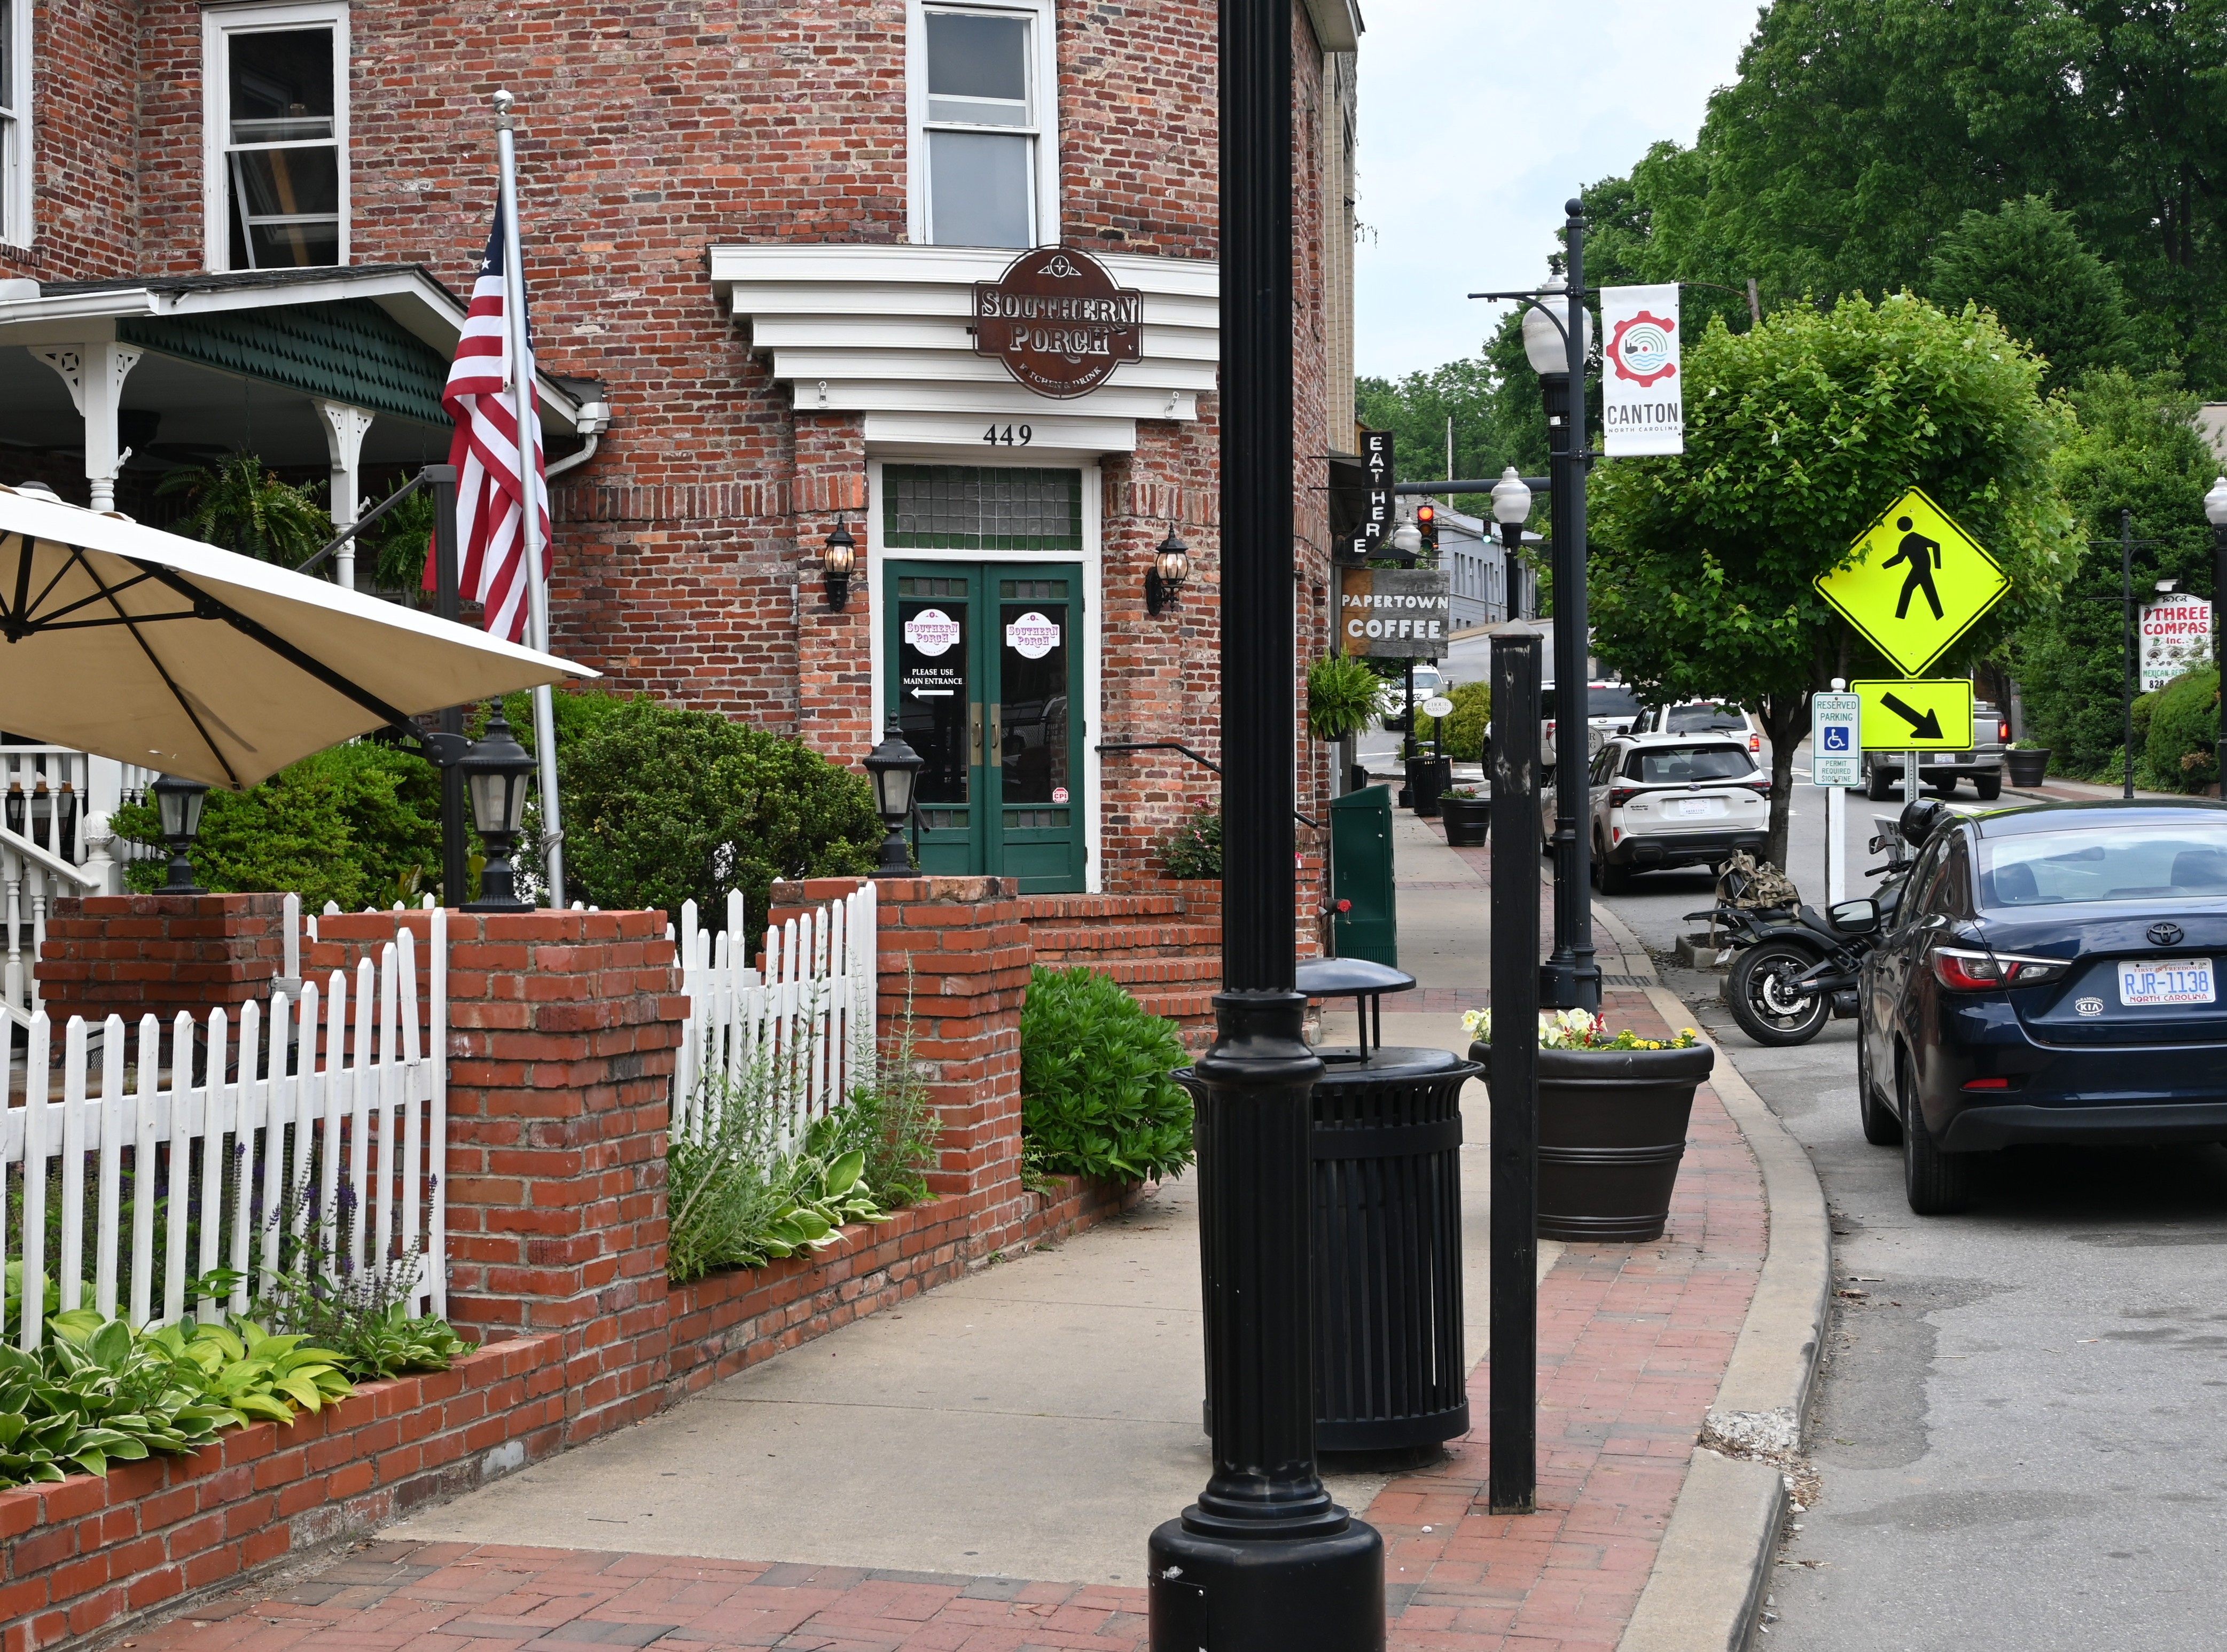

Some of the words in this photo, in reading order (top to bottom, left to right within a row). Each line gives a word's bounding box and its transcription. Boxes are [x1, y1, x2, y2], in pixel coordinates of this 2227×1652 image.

[982, 289, 1137, 334] SOUTHERN
[1010, 323, 1109, 364] PORCH
[1019, 363, 1062, 389] KITCHEN
[1073, 365, 1102, 387] DRINK
[1607, 403, 1678, 425] CANTON
[983, 424, 1032, 446] 449
[1369, 436, 1385, 483] EAT
[1354, 491, 1386, 553] HERE
[1342, 594, 1448, 609] PAPERTOWN
[2153, 606, 2209, 621] THREE
[907, 623, 958, 636] SOUTHERN
[1009, 626, 1058, 638] SOUTHERN
[1348, 619, 1441, 639] COFFEE
[2144, 622, 2207, 635] COMPAS
[916, 633, 949, 645] PORCH
[1018, 636, 1049, 648] PORCH
[2143, 669, 2168, 677] MEXICAN
[1817, 701, 1856, 709] RESERVED
[1820, 713, 1853, 721] PARKING
[2124, 971, 2208, 995] RJR-1138
